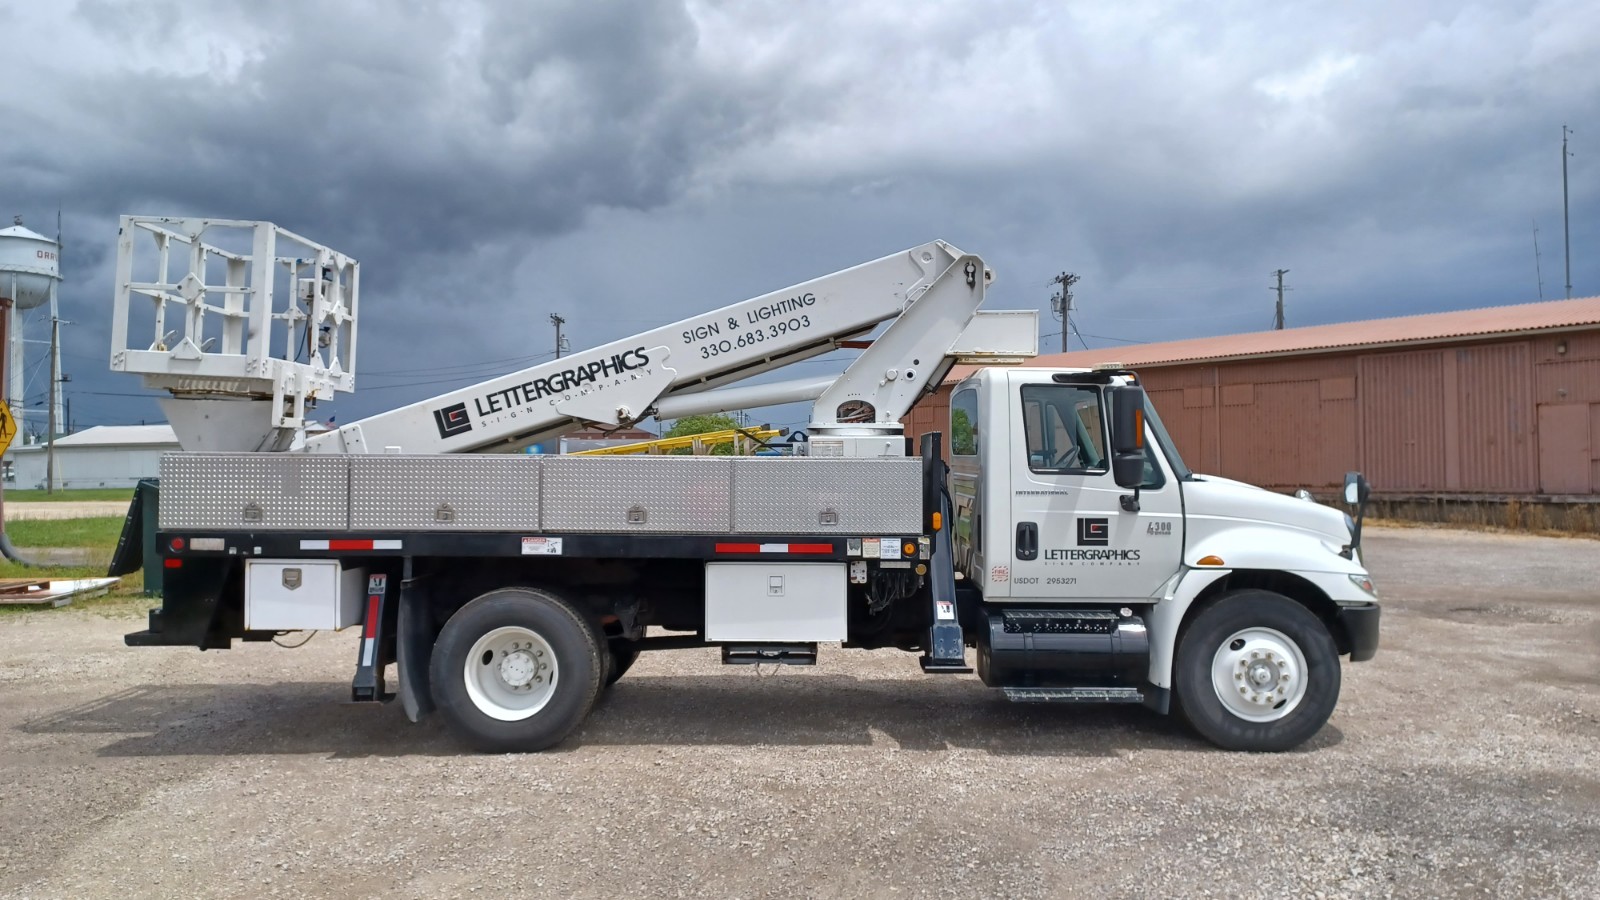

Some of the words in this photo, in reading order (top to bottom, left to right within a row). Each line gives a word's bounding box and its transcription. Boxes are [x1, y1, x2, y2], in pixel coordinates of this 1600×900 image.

[682, 322, 720, 344] SIGN
[727, 317, 740, 330] &
[746, 293, 816, 324] LIGHTING
[700, 315, 811, 359] 330.683.3903
[474, 346, 650, 417] LETTERGRAPHICS
[1044, 549, 1141, 560] LETTERGRAPHICS
[1013, 577, 1040, 585] USDOT
[1046, 577, 1077, 585] 2953271
